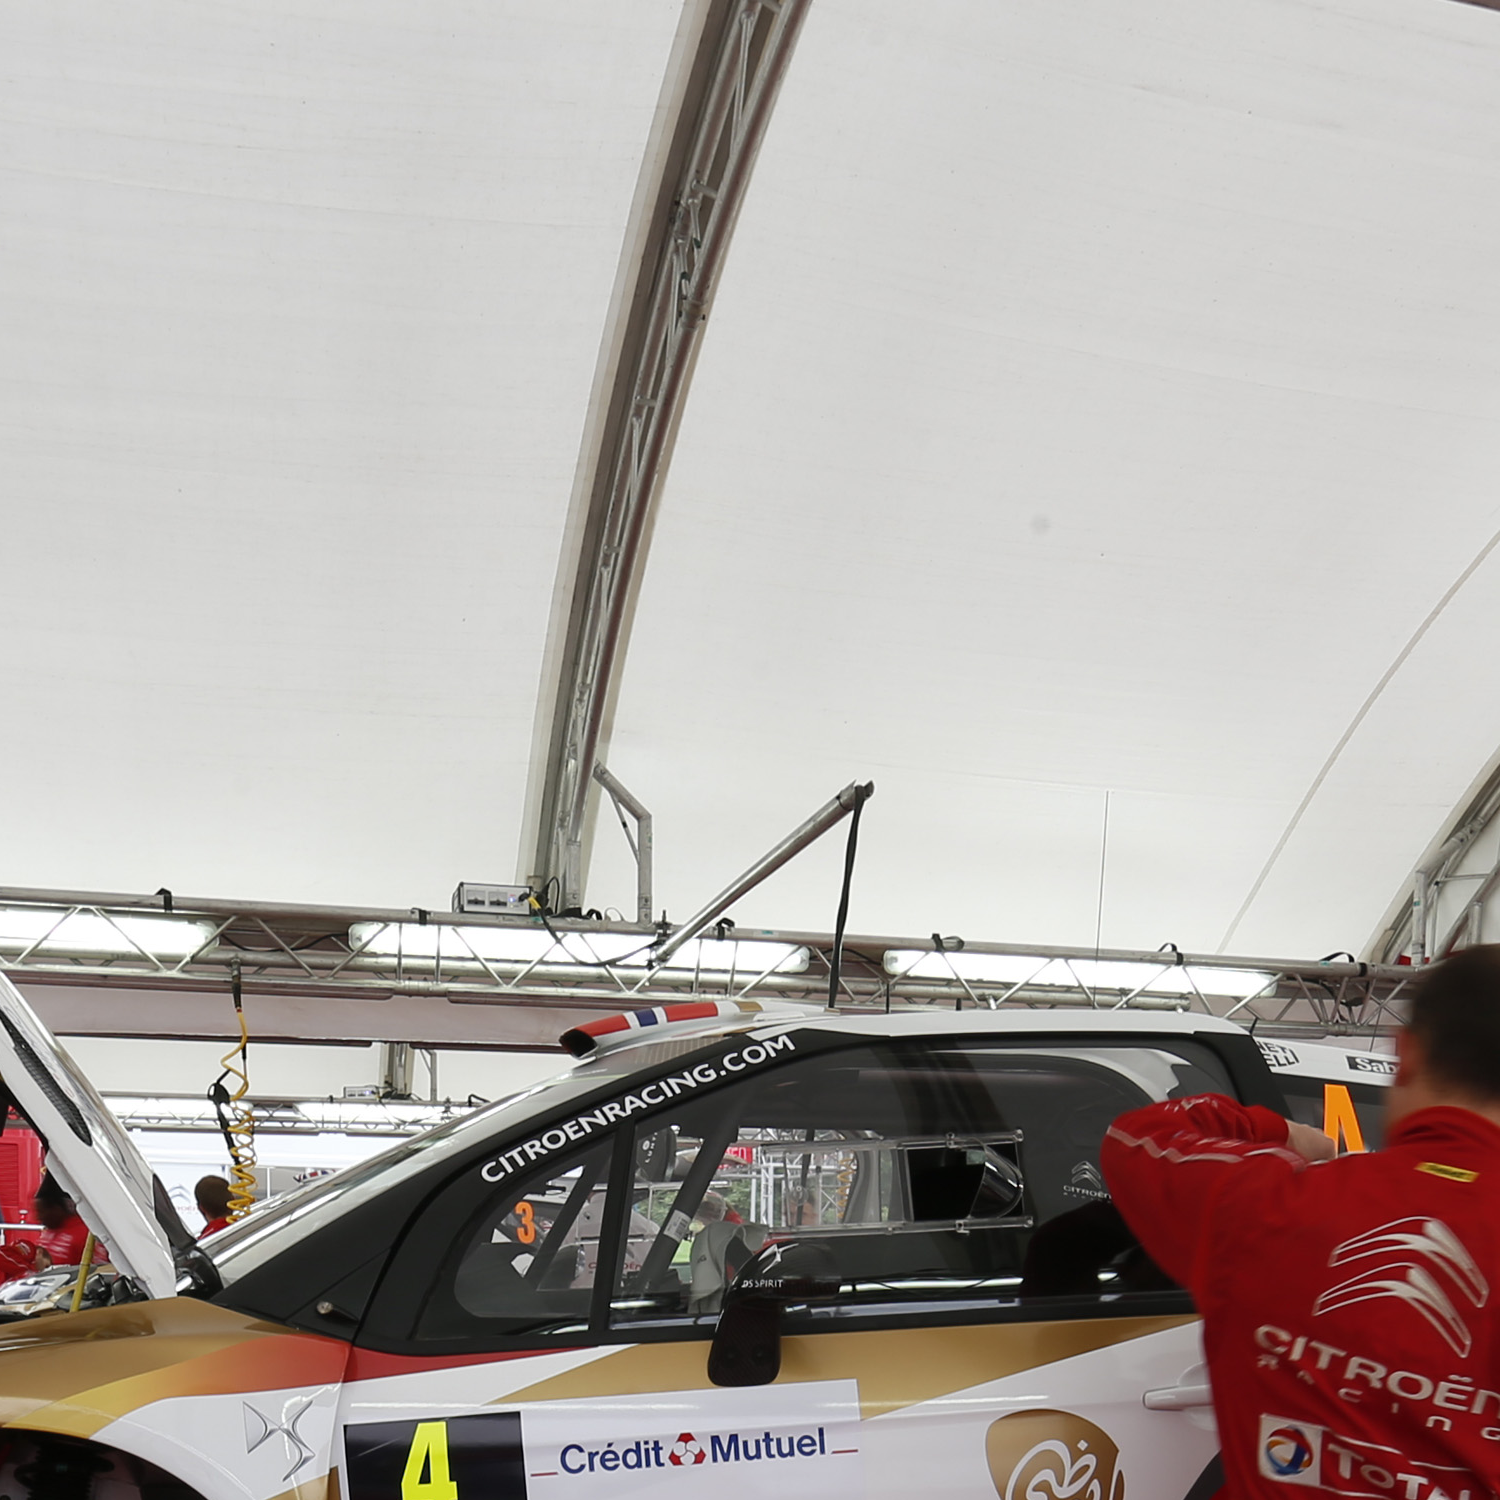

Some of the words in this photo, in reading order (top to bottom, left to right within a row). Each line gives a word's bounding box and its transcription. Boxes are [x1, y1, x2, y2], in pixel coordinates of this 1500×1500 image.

[481, 1034, 796, 1183] CITROENRACING.COM
[514, 1200, 536, 1244] 3
[755, 1279, 784, 1288] SPIRIT
[559, 1439, 665, 1476] Crédit
[711, 1427, 827, 1463] Mutuel
